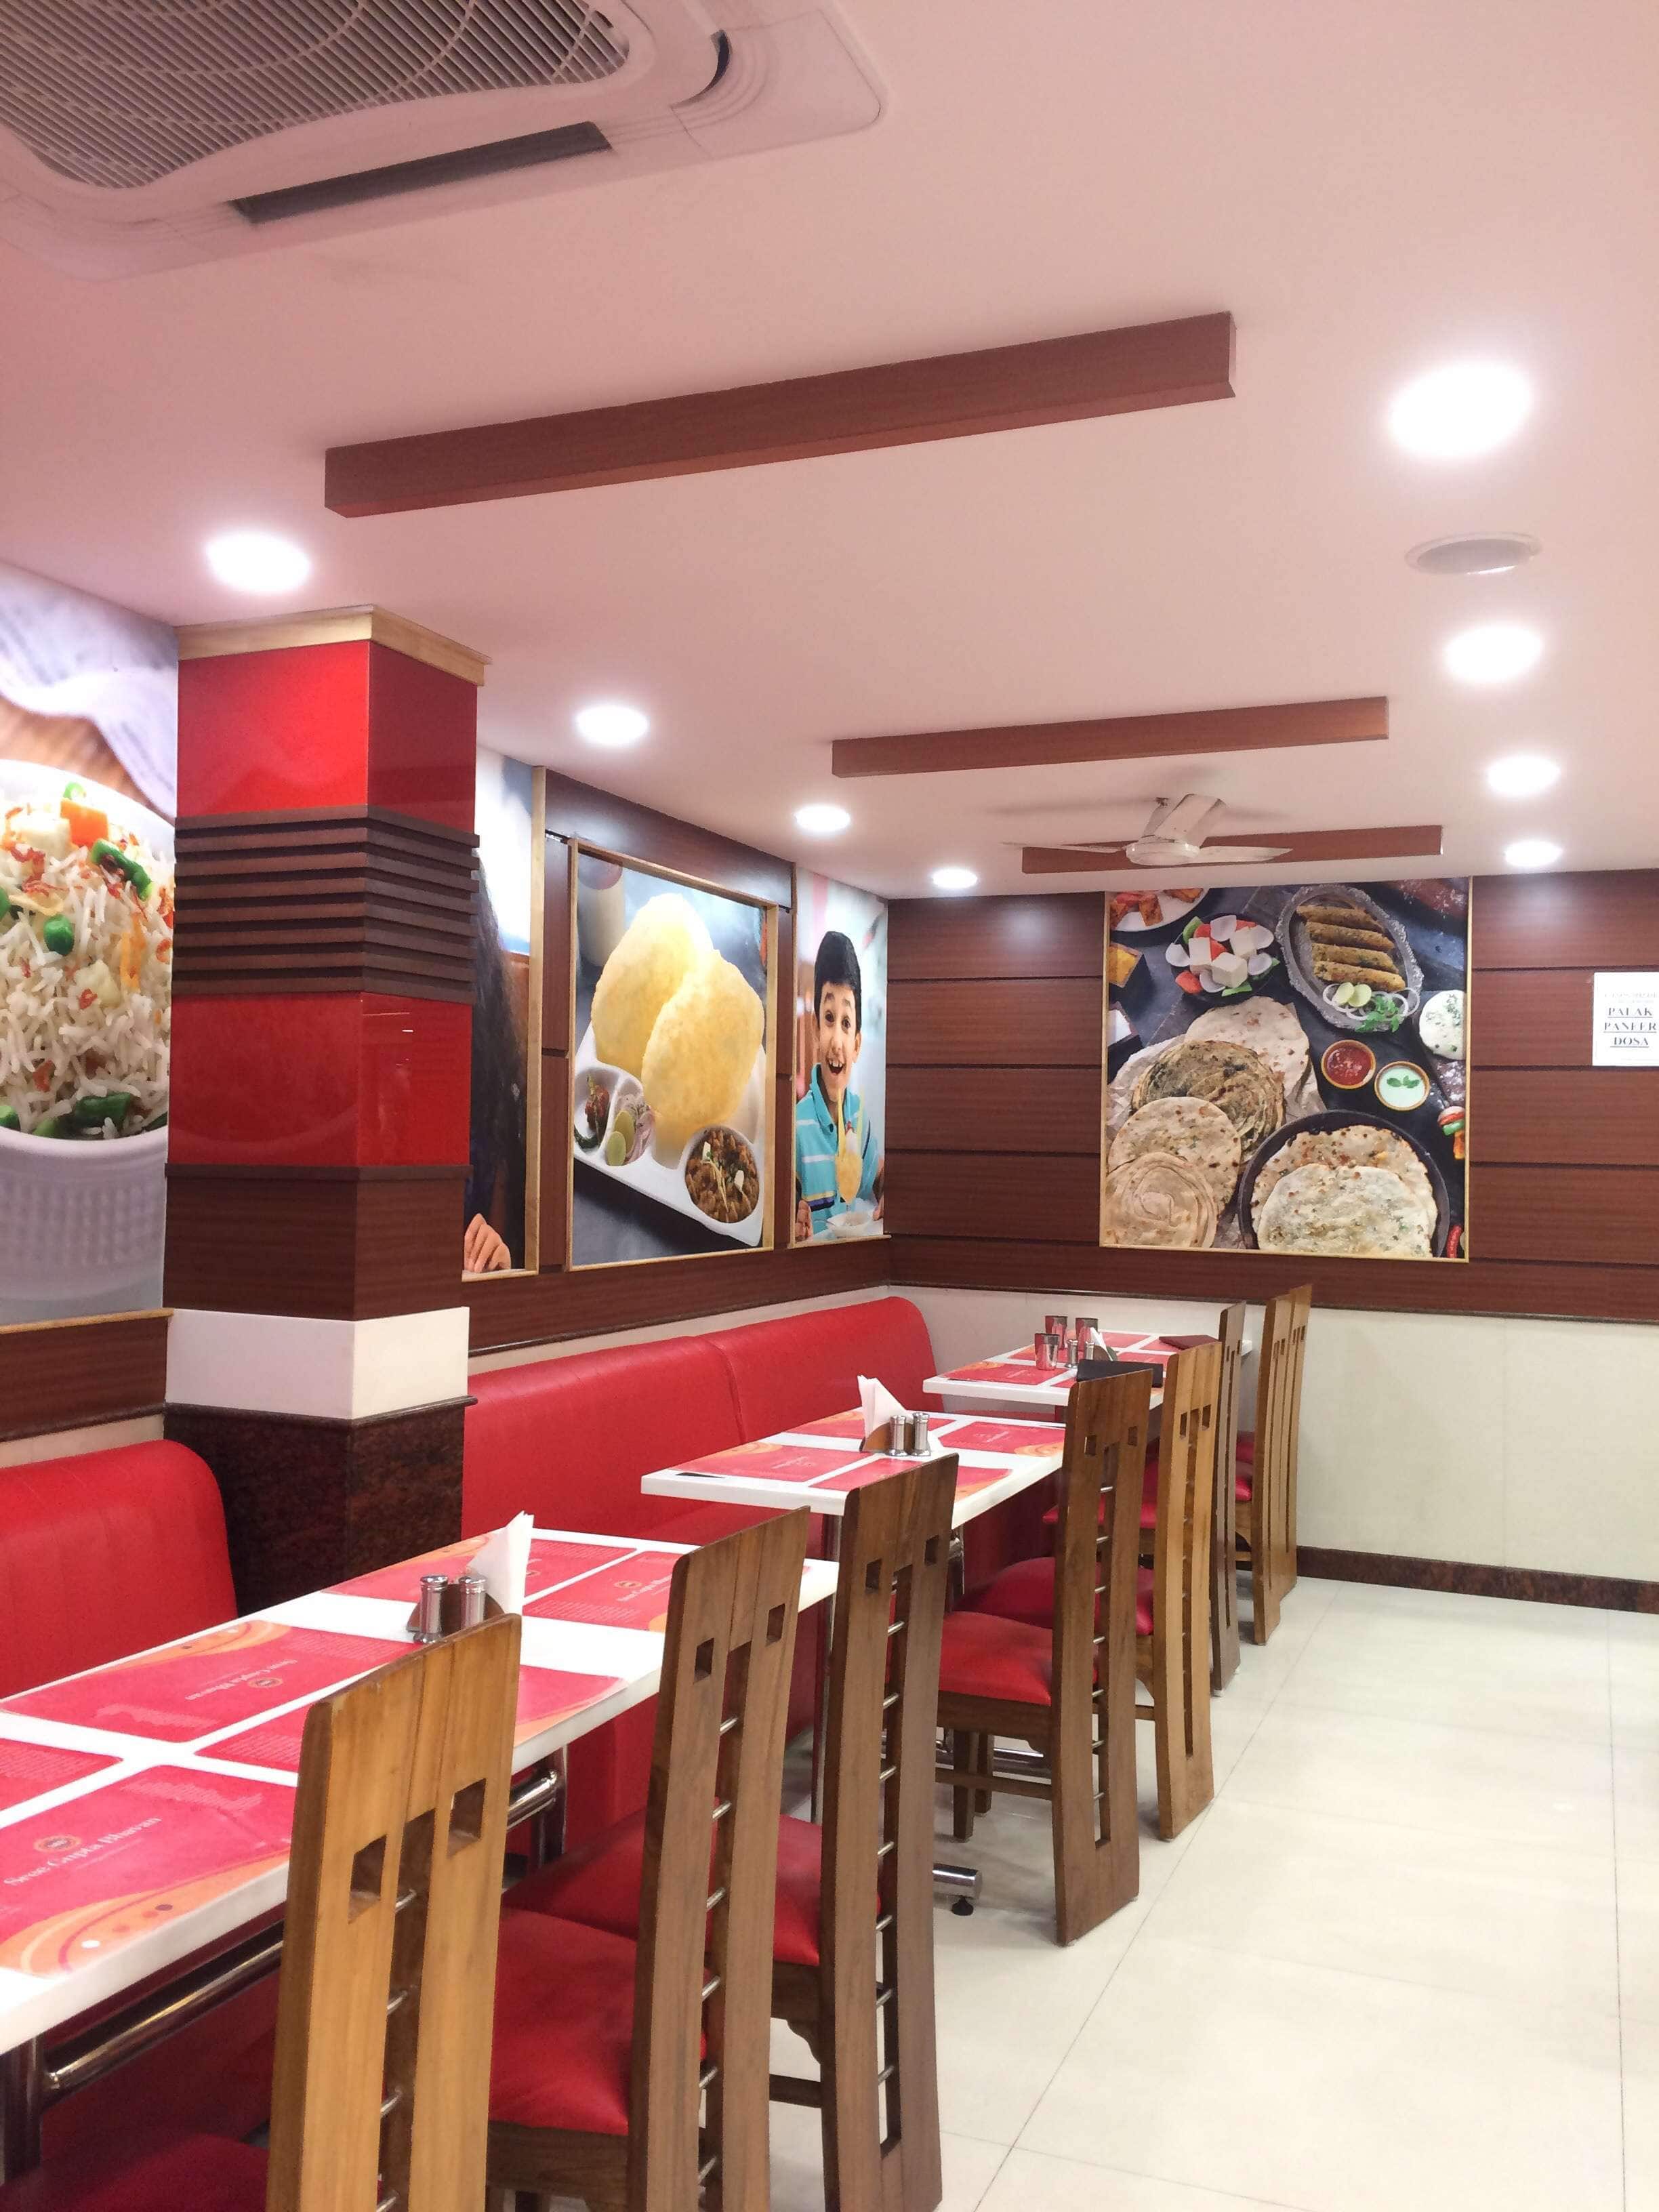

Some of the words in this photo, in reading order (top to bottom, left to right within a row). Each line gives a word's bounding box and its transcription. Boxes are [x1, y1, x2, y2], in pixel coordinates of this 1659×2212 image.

[1608, 1007, 1653, 1016] PALAK
[1603, 1022, 1657, 1031] PANEER
[1614, 1037, 1649, 1046] DOSA
